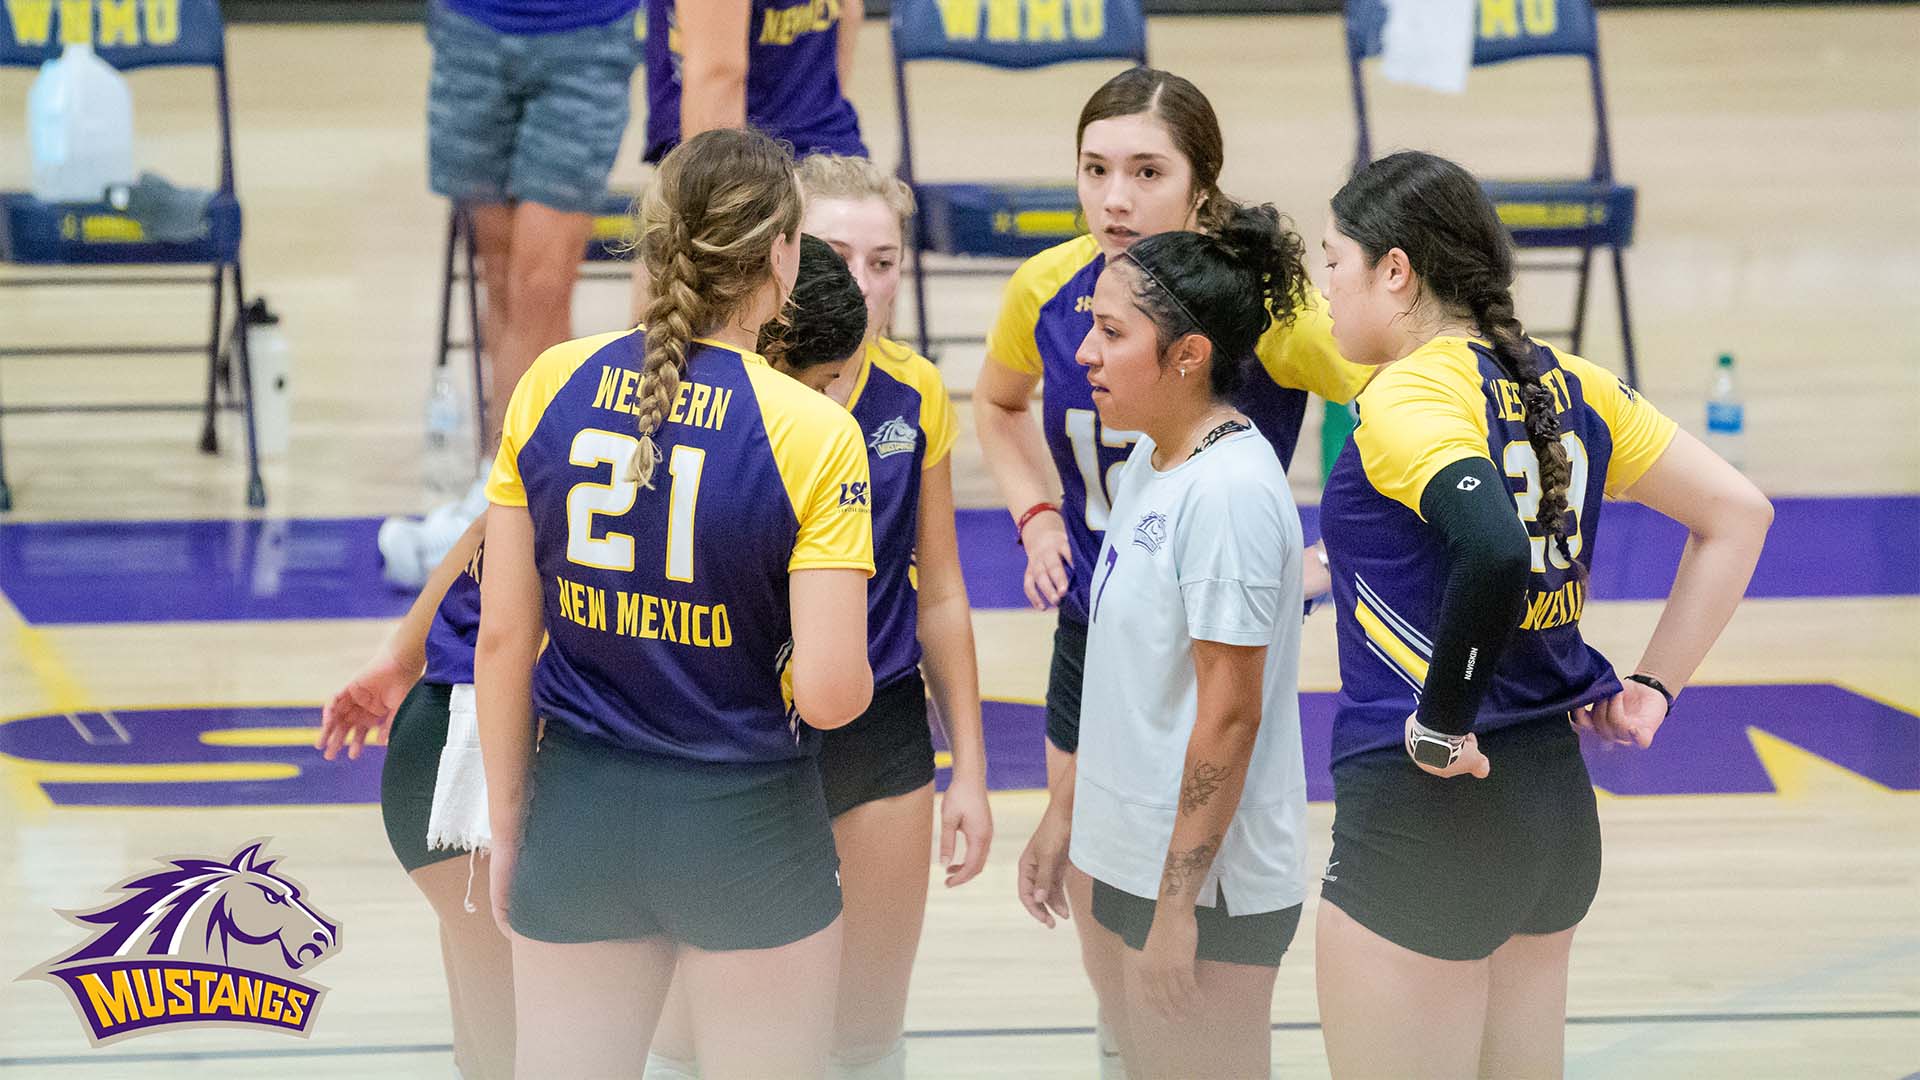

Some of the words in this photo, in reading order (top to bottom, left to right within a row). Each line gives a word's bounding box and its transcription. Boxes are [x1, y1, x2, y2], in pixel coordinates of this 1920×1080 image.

[592, 365, 733, 431] WEERN
[566, 428, 706, 583] 21
[556, 576, 607, 631] NEW
[616, 591, 733, 647] MEXICO
